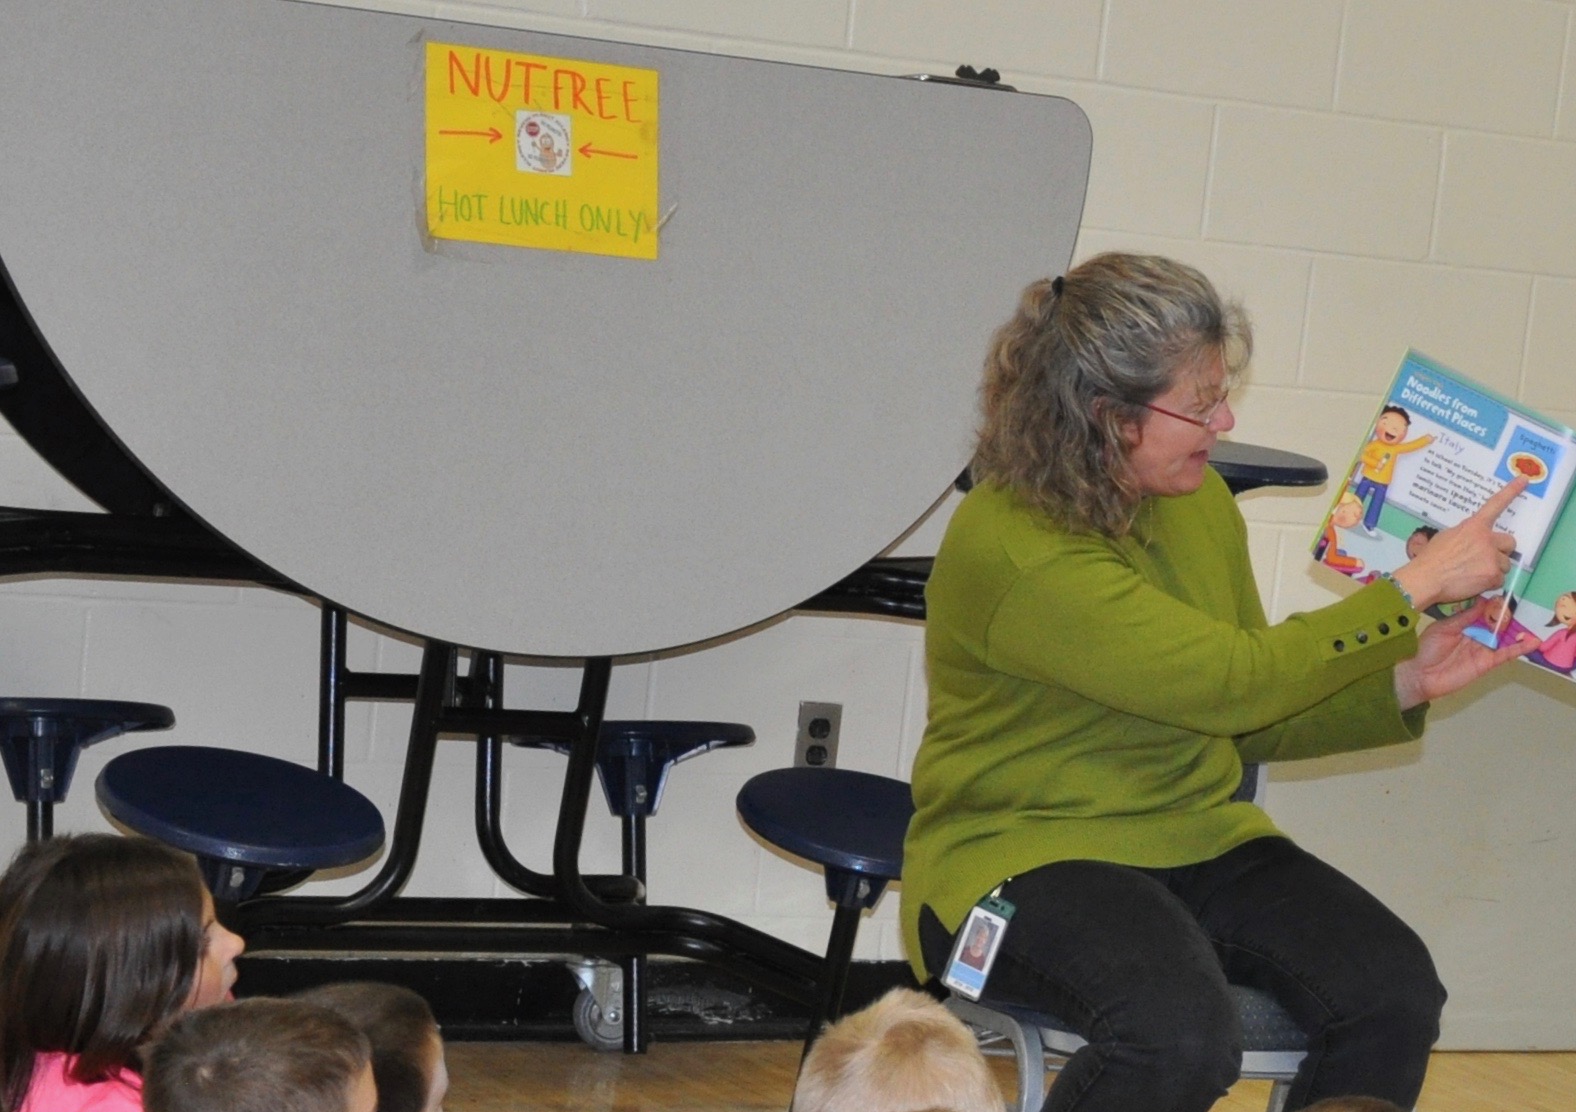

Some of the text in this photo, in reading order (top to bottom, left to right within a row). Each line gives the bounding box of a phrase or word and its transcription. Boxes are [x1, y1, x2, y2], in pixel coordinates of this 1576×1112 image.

[449, 50, 642, 123] NUT FREE
[438, 185, 644, 243] HOT LUNCH ONLY
[1401, 388, 1486, 437] Different Places
[1406, 375, 1450, 404] Noodles
[1452, 398, 1478, 417] from
[1438, 432, 1465, 455] Italy
